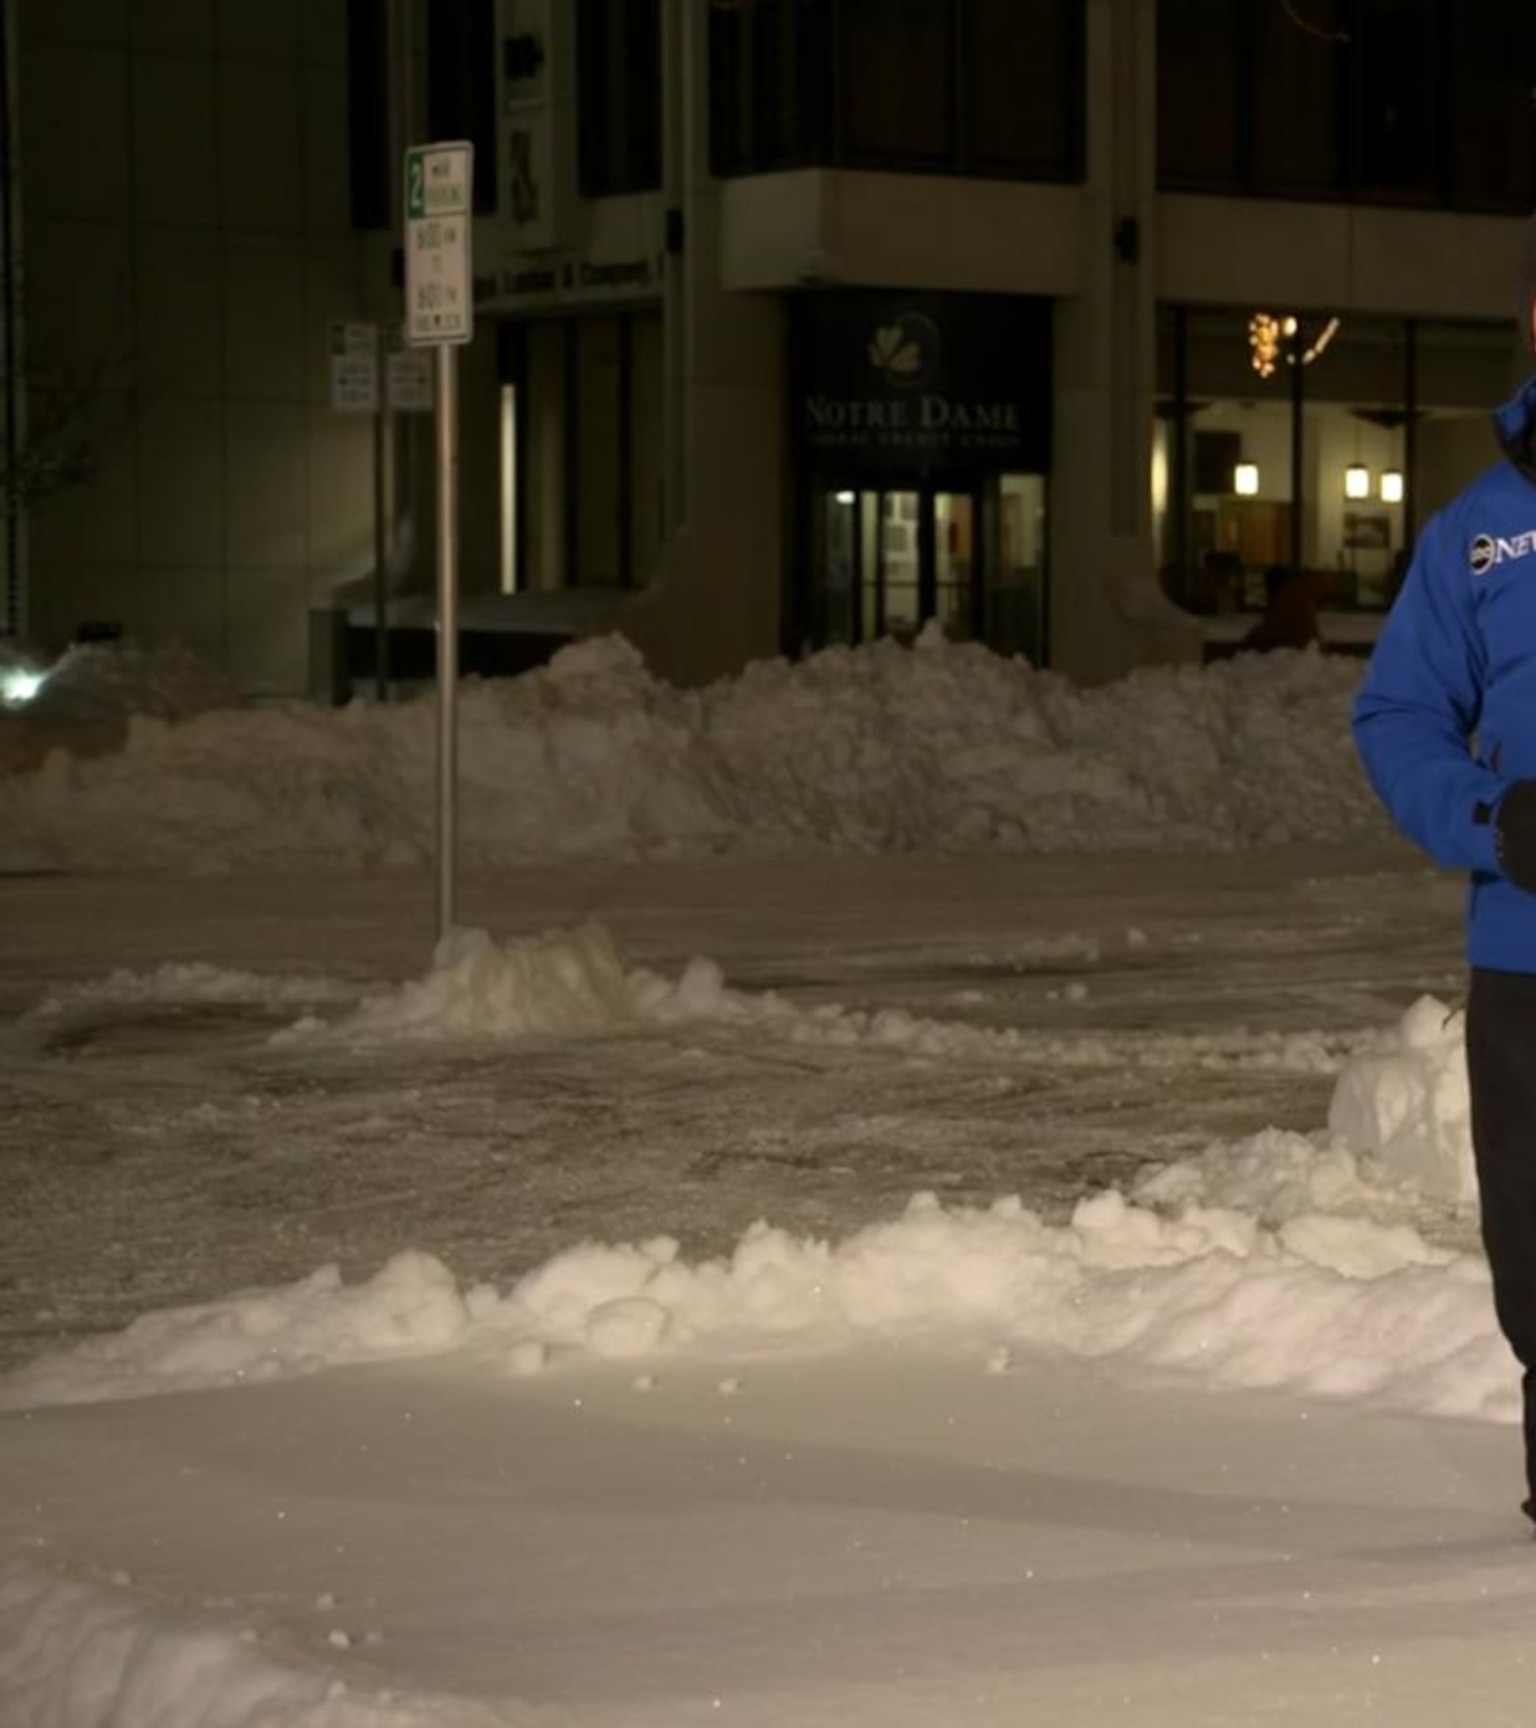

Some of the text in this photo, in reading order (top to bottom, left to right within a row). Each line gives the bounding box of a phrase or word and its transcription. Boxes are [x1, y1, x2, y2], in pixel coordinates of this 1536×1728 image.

[412, 163, 422, 208] 2
[805, 394, 1021, 430] NOTRE DAME
